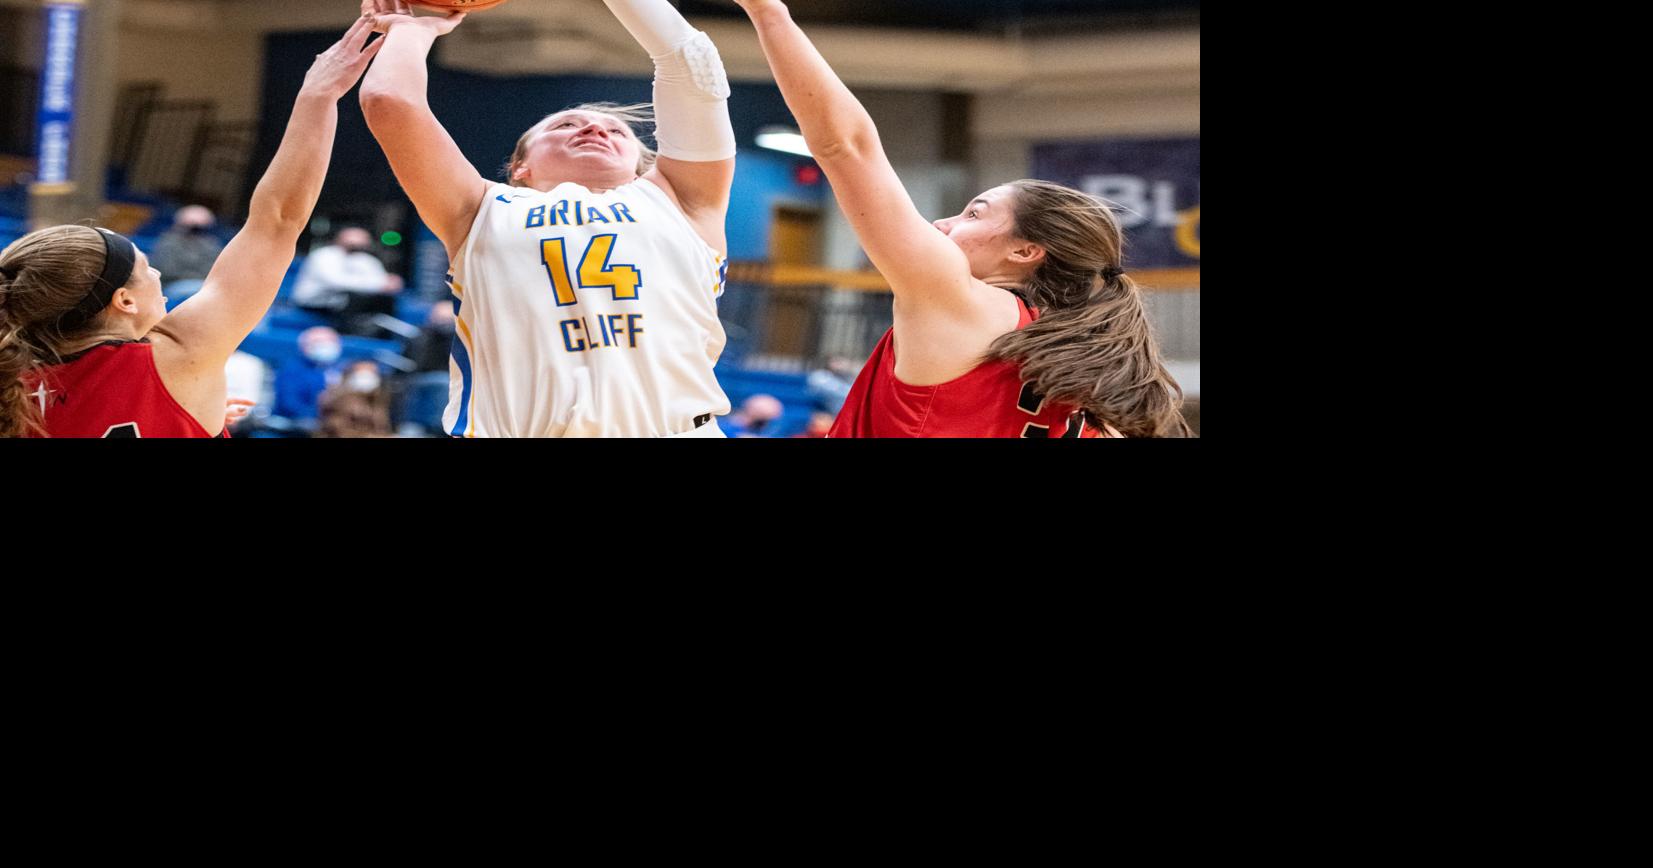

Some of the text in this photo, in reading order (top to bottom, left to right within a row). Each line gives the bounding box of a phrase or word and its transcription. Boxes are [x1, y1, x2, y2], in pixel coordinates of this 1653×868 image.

[525, 200, 637, 228] BRIAR
[540, 233, 643, 307] 14
[559, 313, 644, 352] CLIFF
